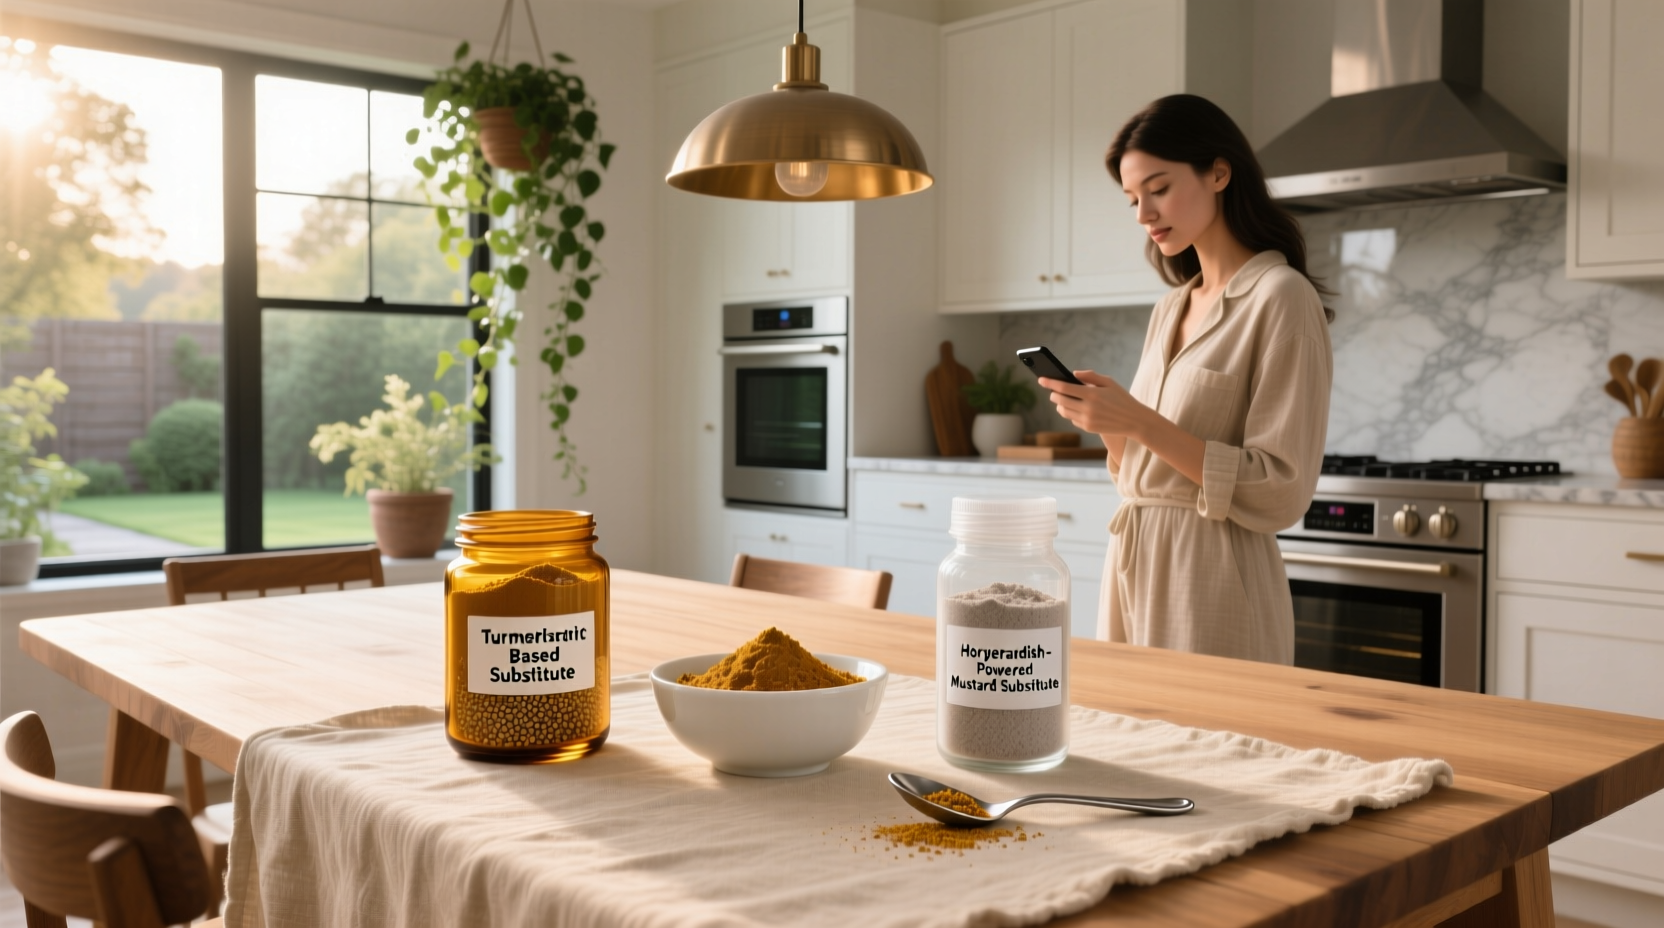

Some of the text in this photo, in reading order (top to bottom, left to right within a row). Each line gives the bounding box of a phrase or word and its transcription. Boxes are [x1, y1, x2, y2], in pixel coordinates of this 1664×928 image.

[509, 646, 560, 664] Based
[490, 666, 576, 683] Substitute
[977, 661, 1033, 676] Powered
[950, 674, 997, 692] Mustard
